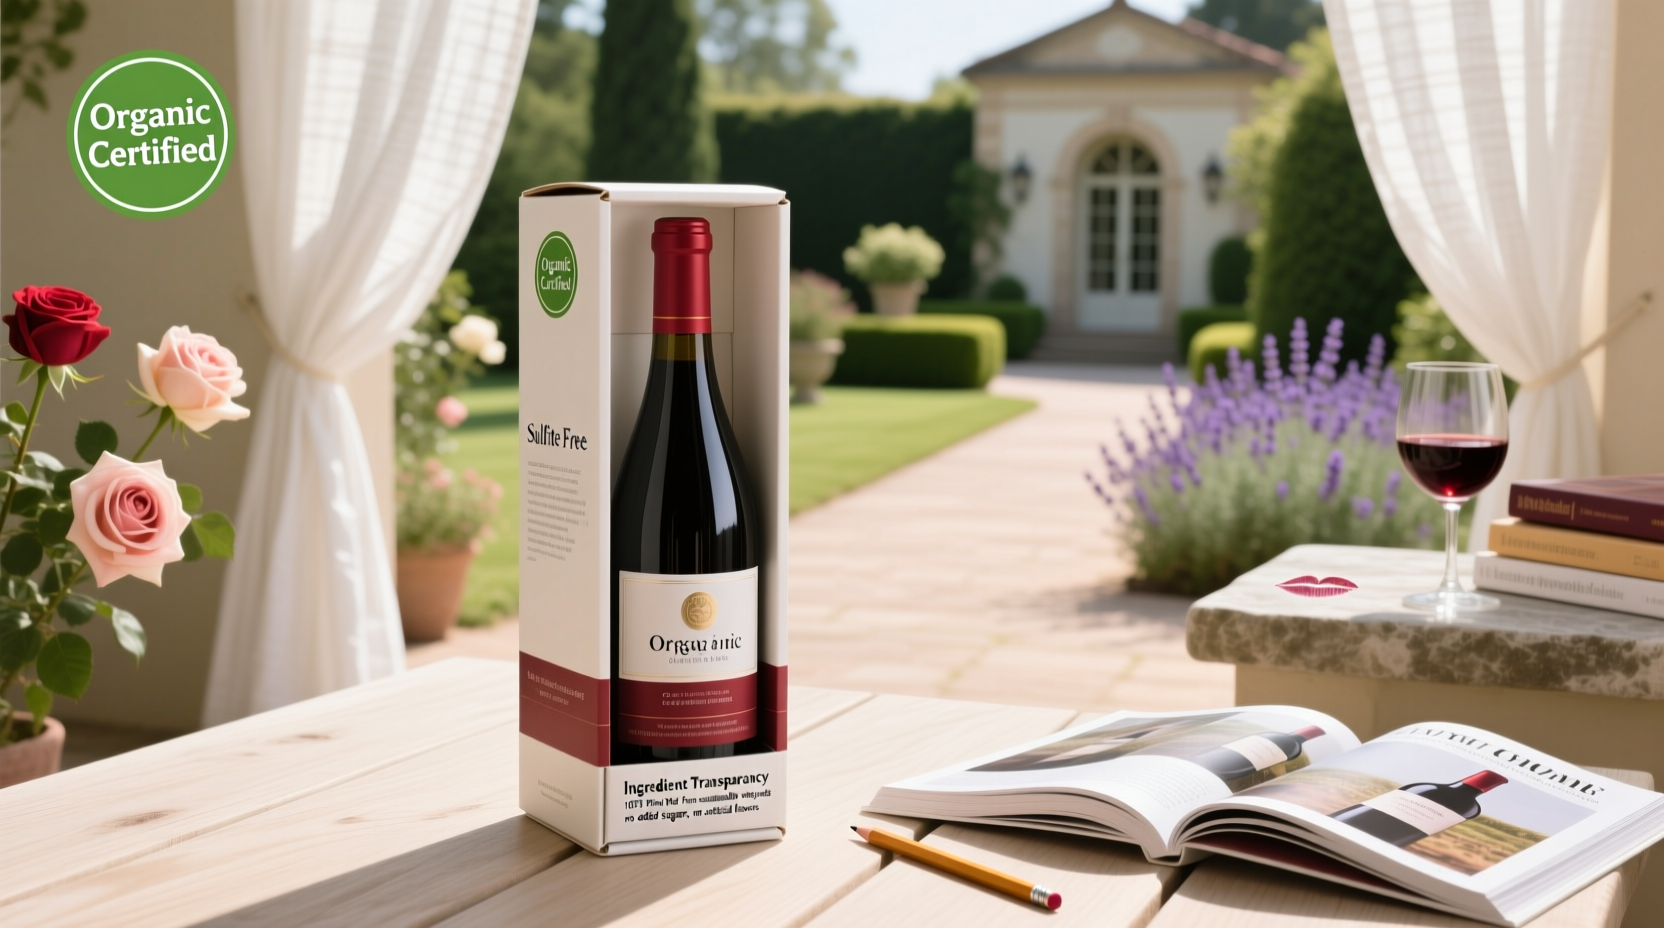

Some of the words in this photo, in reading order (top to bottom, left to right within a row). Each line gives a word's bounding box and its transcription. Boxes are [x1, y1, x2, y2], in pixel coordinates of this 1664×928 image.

[527, 423, 561, 447] Sulfite
[563, 427, 588, 451] Free
[624, 778, 688, 797] Ingredient
